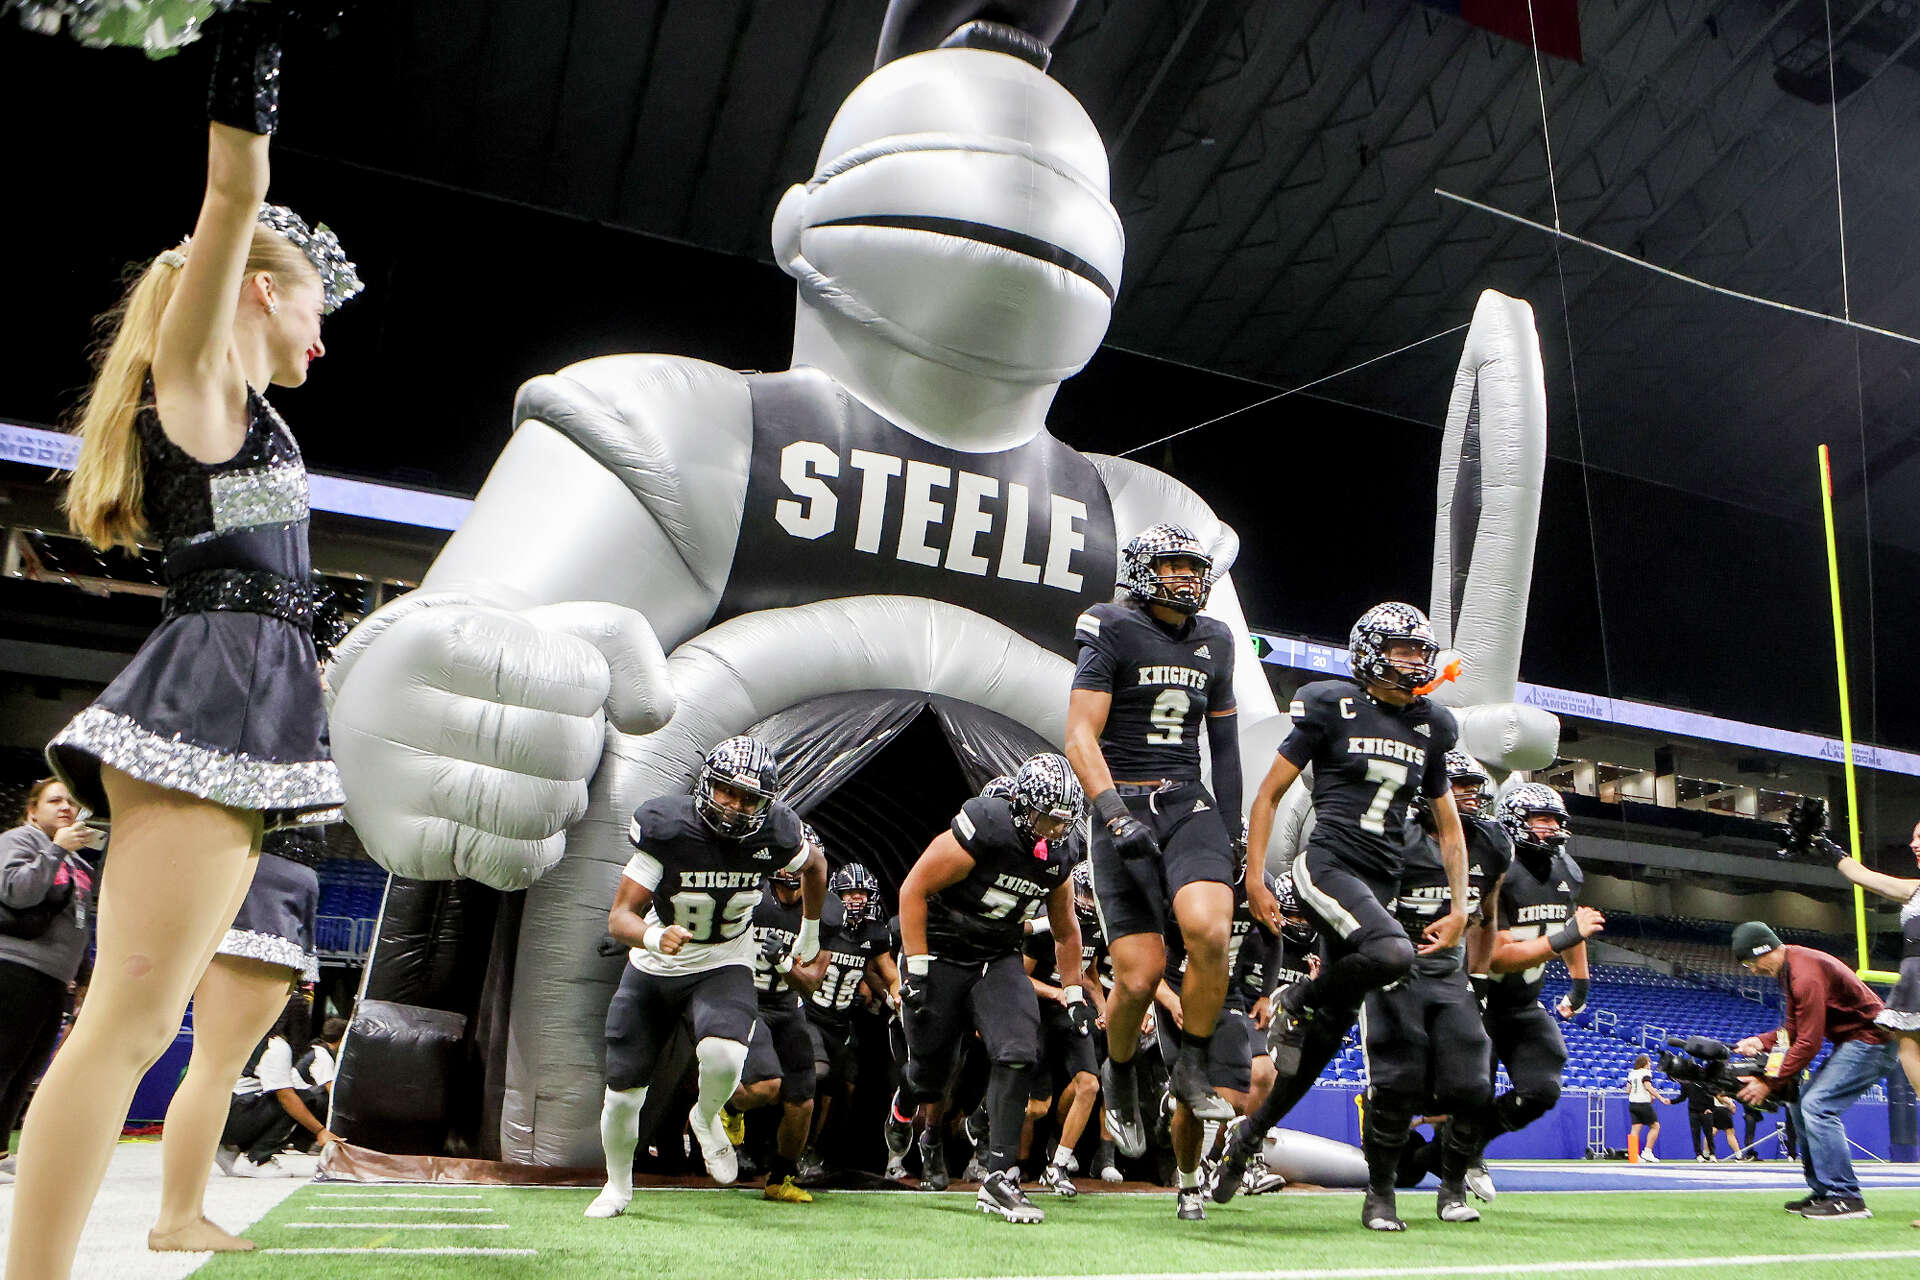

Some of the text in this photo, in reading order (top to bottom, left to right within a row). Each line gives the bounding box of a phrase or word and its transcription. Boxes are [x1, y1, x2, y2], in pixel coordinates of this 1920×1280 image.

[774, 440, 1088, 593] STEELE
[1312, 655, 1327, 668] 20
[1138, 665, 1208, 690] KNIGHTS
[1146, 688, 1191, 745] 9
[1339, 697, 1357, 719] C
[1523, 692, 1604, 718] ALAMODOME
[1347, 737, 1426, 767] KNIGHTS
[1360, 758, 1409, 837] 7
[679, 871, 762, 888] KNIGHTS
[994, 873, 1050, 897] KNIGHTS
[1517, 904, 1568, 923] KNIGHTS
[830, 951, 866, 968] NIGHTS
